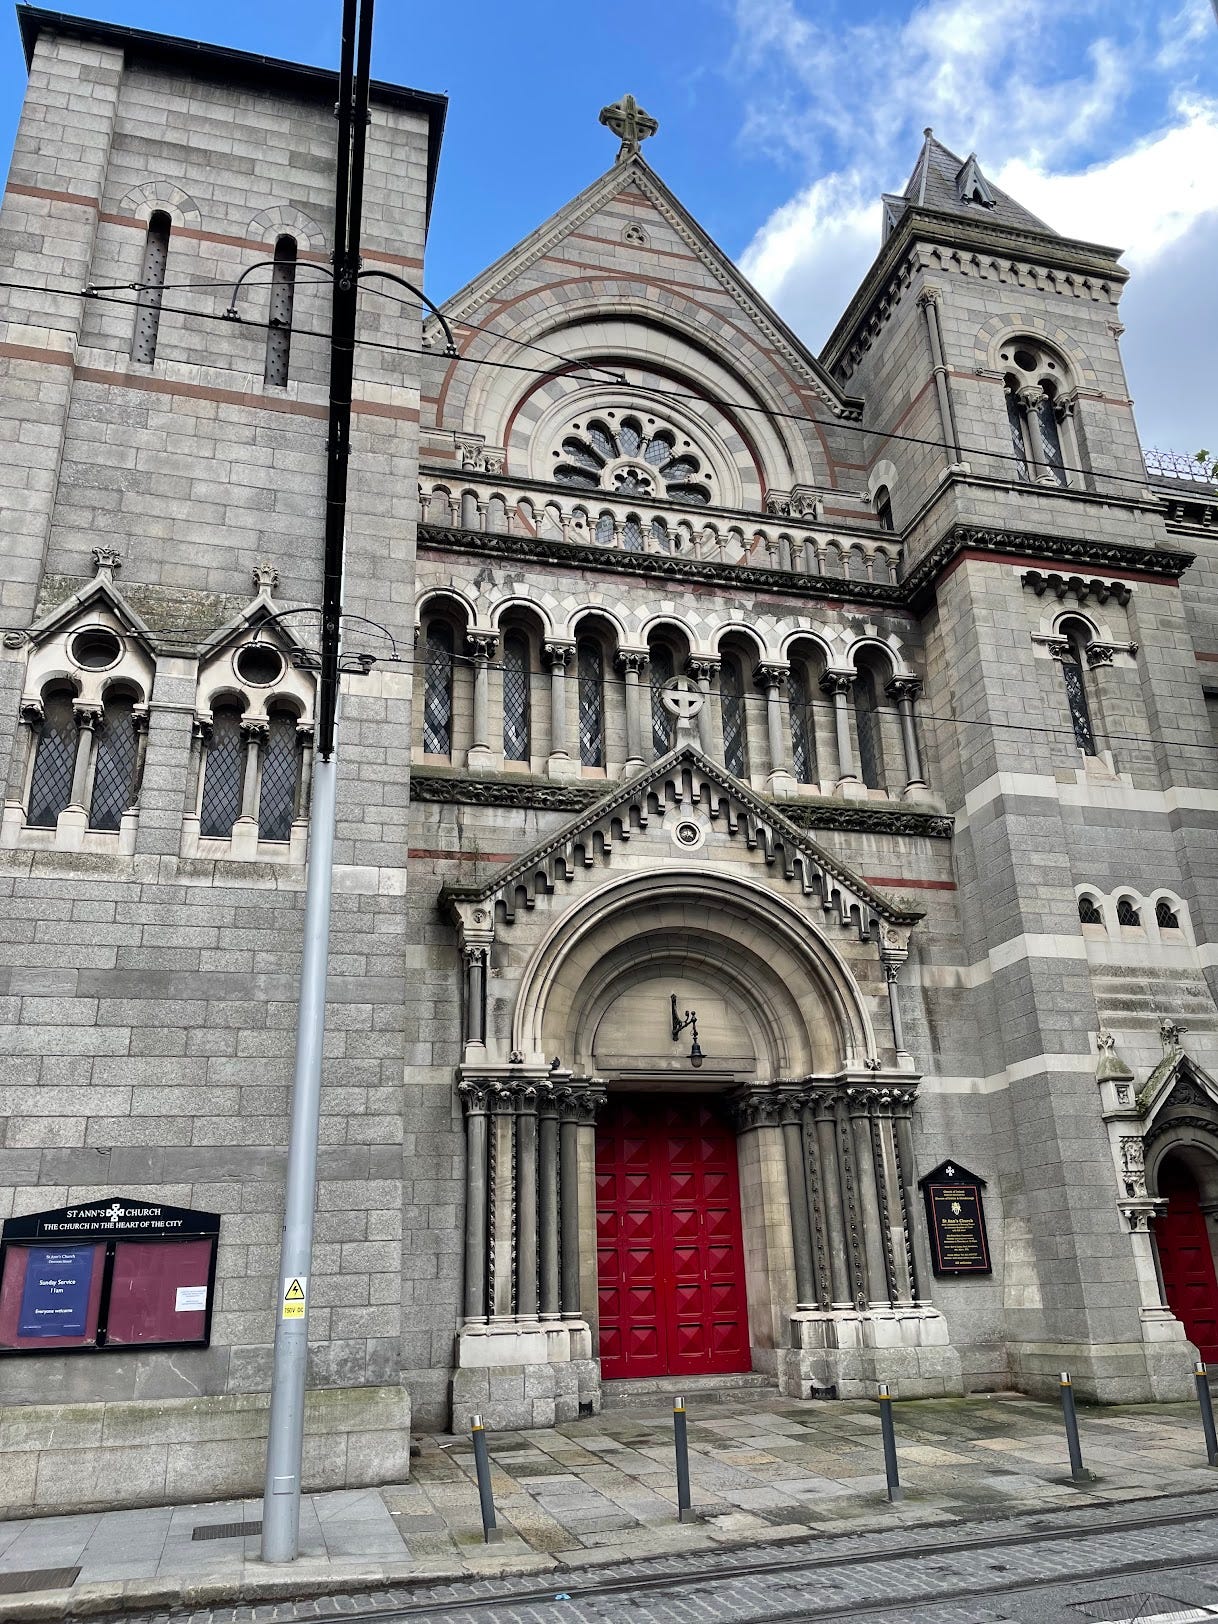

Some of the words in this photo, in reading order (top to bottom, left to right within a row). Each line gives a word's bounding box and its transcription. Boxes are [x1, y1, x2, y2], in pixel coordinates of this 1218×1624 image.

[67, 1210, 79, 1218] ST
[125, 1208, 161, 1217] CHURCH
[90, 1222, 99, 1230] IN
[115, 1221, 139, 1229] HEART
[151, 1220, 165, 1228] THE
